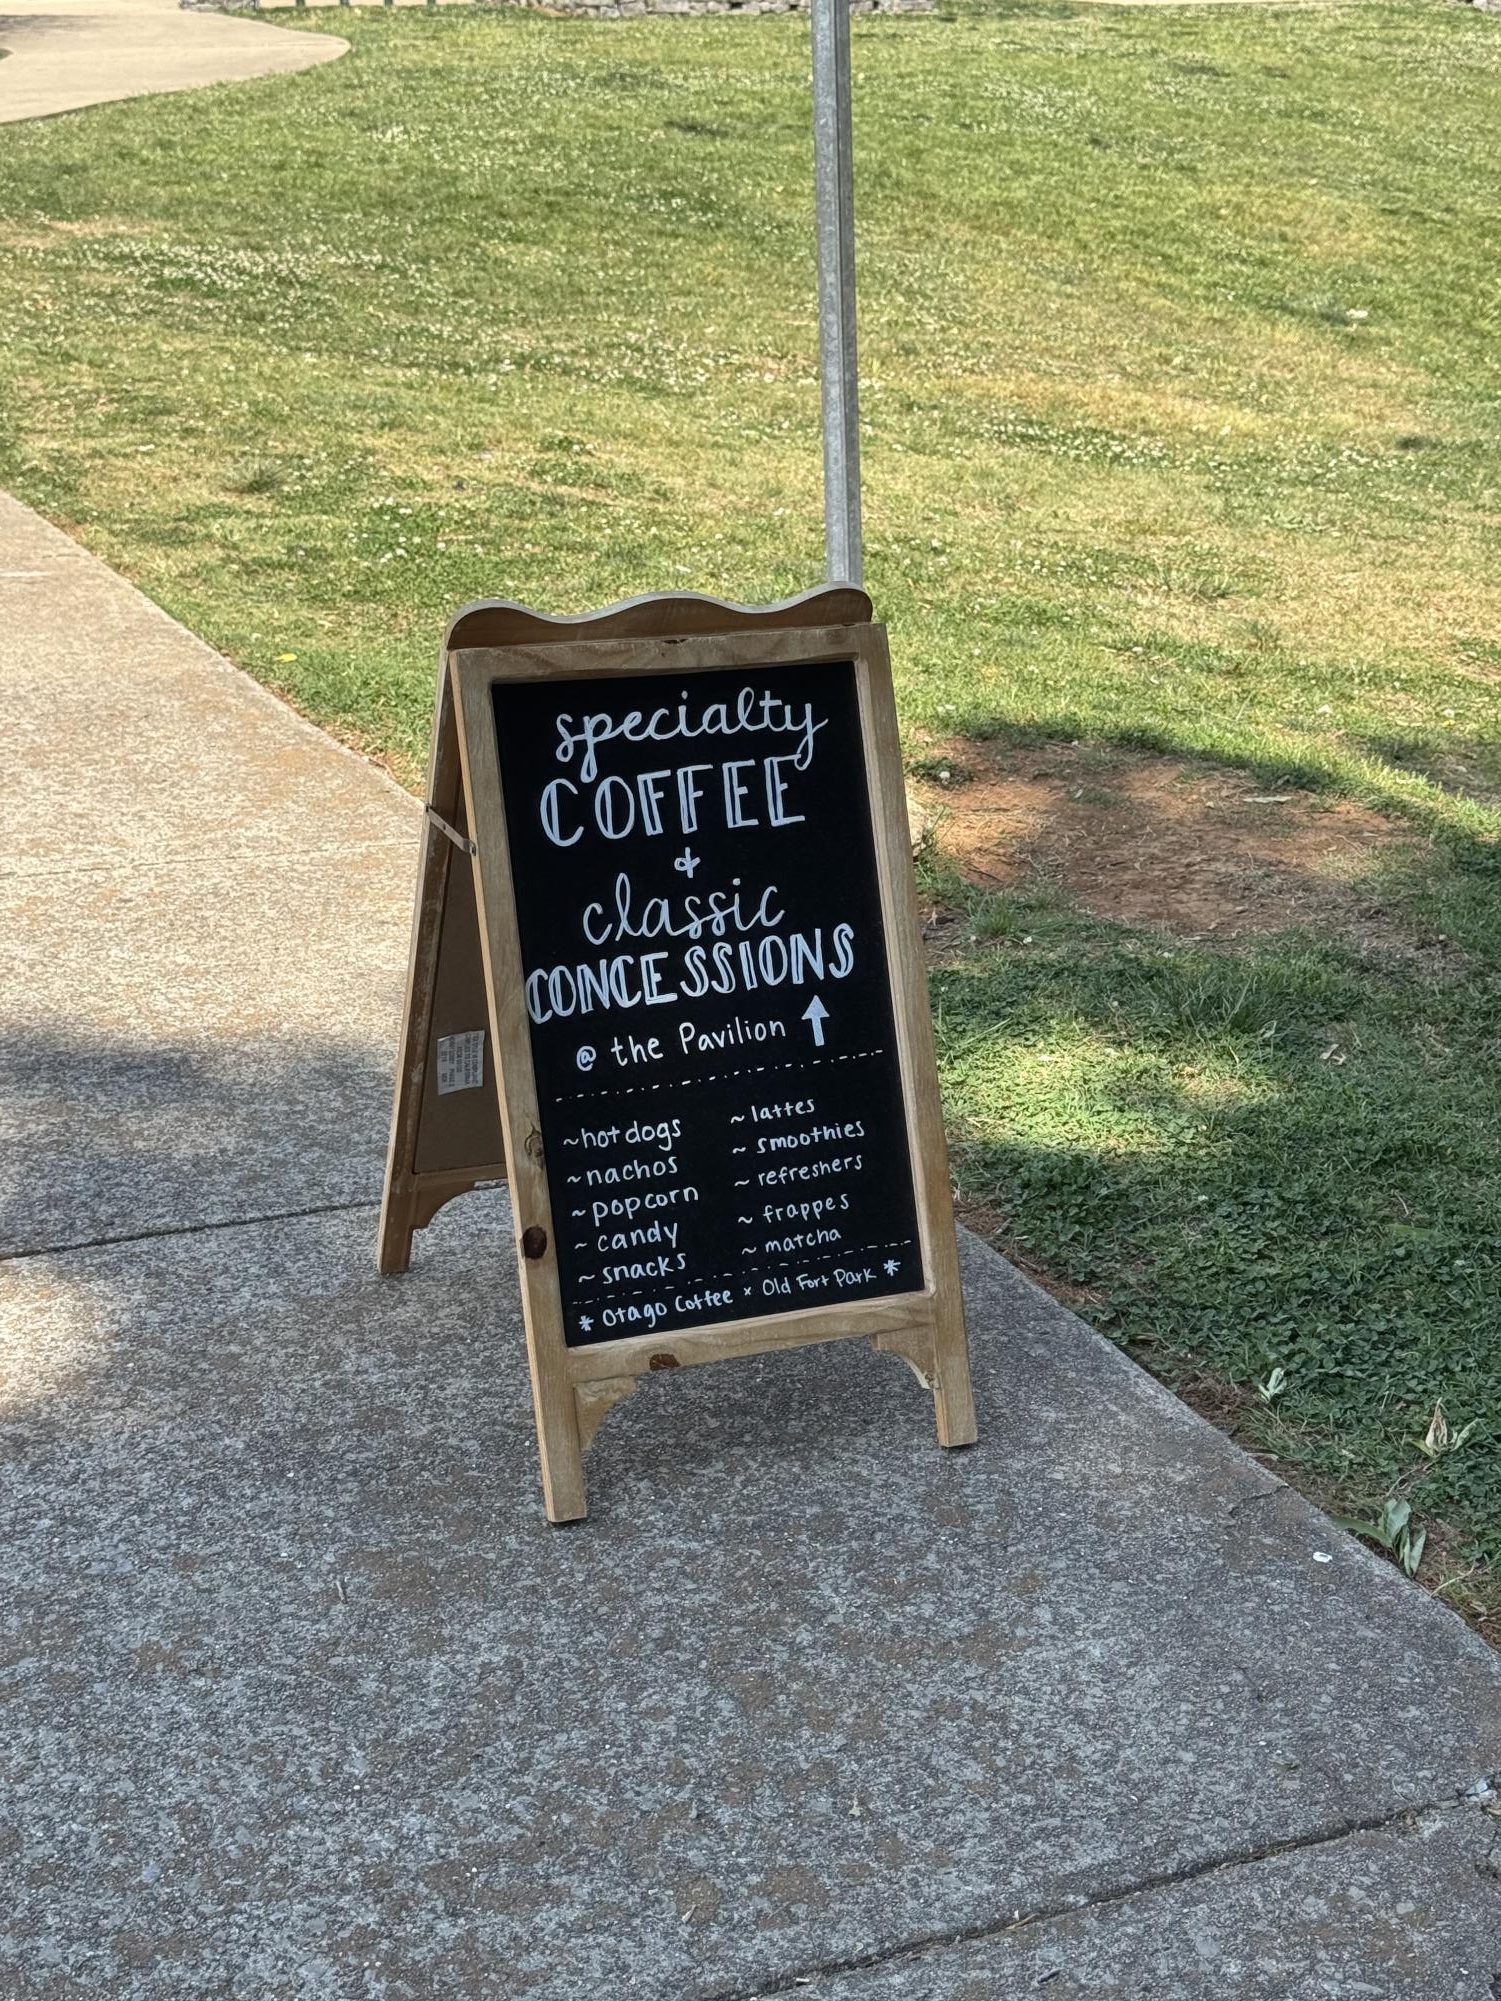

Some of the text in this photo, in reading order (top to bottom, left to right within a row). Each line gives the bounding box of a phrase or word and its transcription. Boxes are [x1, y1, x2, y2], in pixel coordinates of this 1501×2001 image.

[556, 687, 828, 783] specialty
[539, 754, 806, 846] COFFEE
[583, 872, 785, 945] classic
[525, 923, 854, 1025] CONCESSIONS
[577, 1017, 786, 1072] @ the Pavilion
[750, 1098, 815, 1122] lattes
[756, 1120, 865, 1154] smoothies
[586, 1156, 678, 1186] nachos
[757, 1154, 862, 1186] refreshers
[592, 1186, 699, 1227] popcorn
[762, 1193, 849, 1224] frappes
[597, 1220, 678, 1252] candy
[764, 1228, 842, 1253] matcha
[602, 1252, 686, 1285] snacks
[602, 1302, 668, 1329] Otago
[674, 1289, 734, 1313] Coffee
[762, 1277, 792, 1296] Old
[795, 1273, 830, 1291] Fort
[832, 1268, 877, 1288] Park
